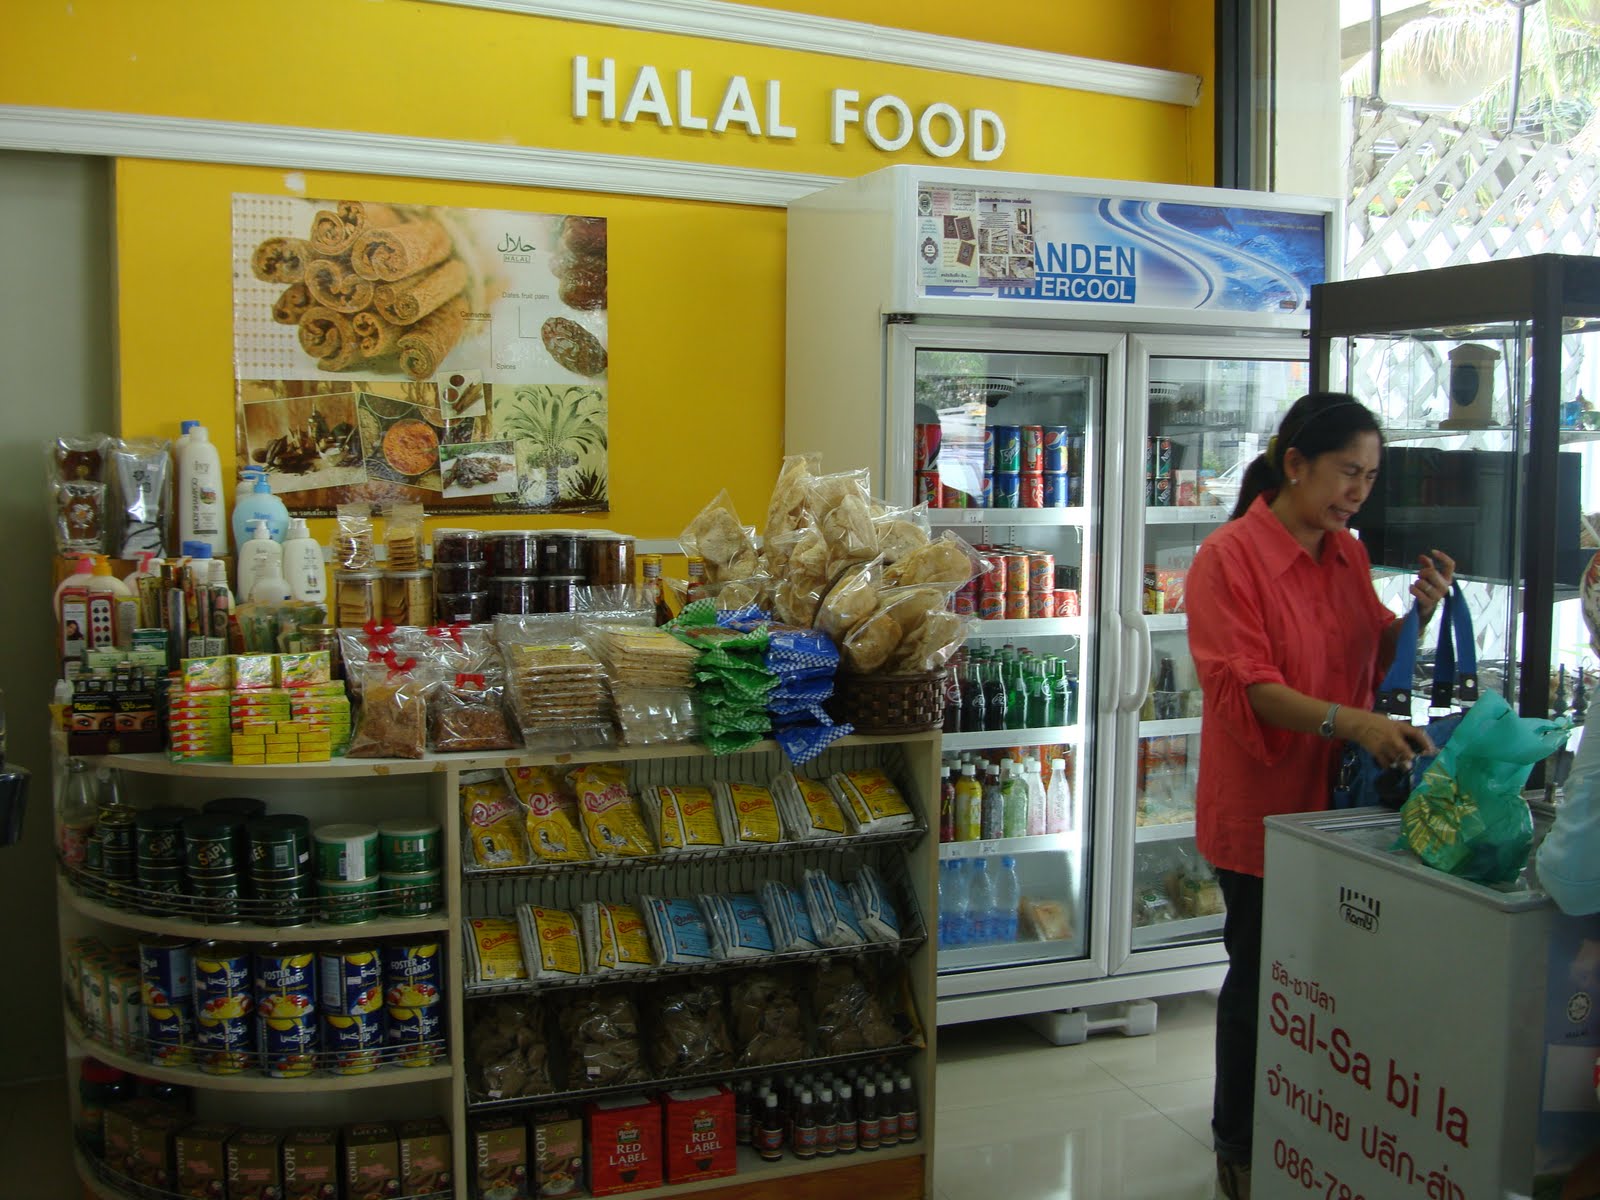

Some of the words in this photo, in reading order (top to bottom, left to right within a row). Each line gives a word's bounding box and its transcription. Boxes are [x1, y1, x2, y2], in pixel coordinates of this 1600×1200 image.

[572, 55, 797, 138] HALAL
[831, 88, 1006, 162] FOOD
[497, 232, 536, 253] حلال
[504, 255, 530, 263] HALAL
[1034, 242, 1136, 276] ANDEN
[197, 842, 227, 866] SAPI
[264, 969, 290, 980] FOSTER
[1270, 992, 1372, 1090] Sal-Sa
[1387, 1058, 1420, 1117] bi
[1436, 1086, 1469, 1148] la
[1267, 1063, 1350, 1141] จำหน่าย
[535, 1128, 547, 1162] KOPI
[616, 1143, 642, 1155] RED
[685, 1140, 723, 1155] LABEL
[692, 1131, 717, 1144] RED
[478, 1134, 489, 1168] KOPI
[609, 1153, 648, 1166] LABEL
[1274, 1139, 1366, 1200] 086-78
